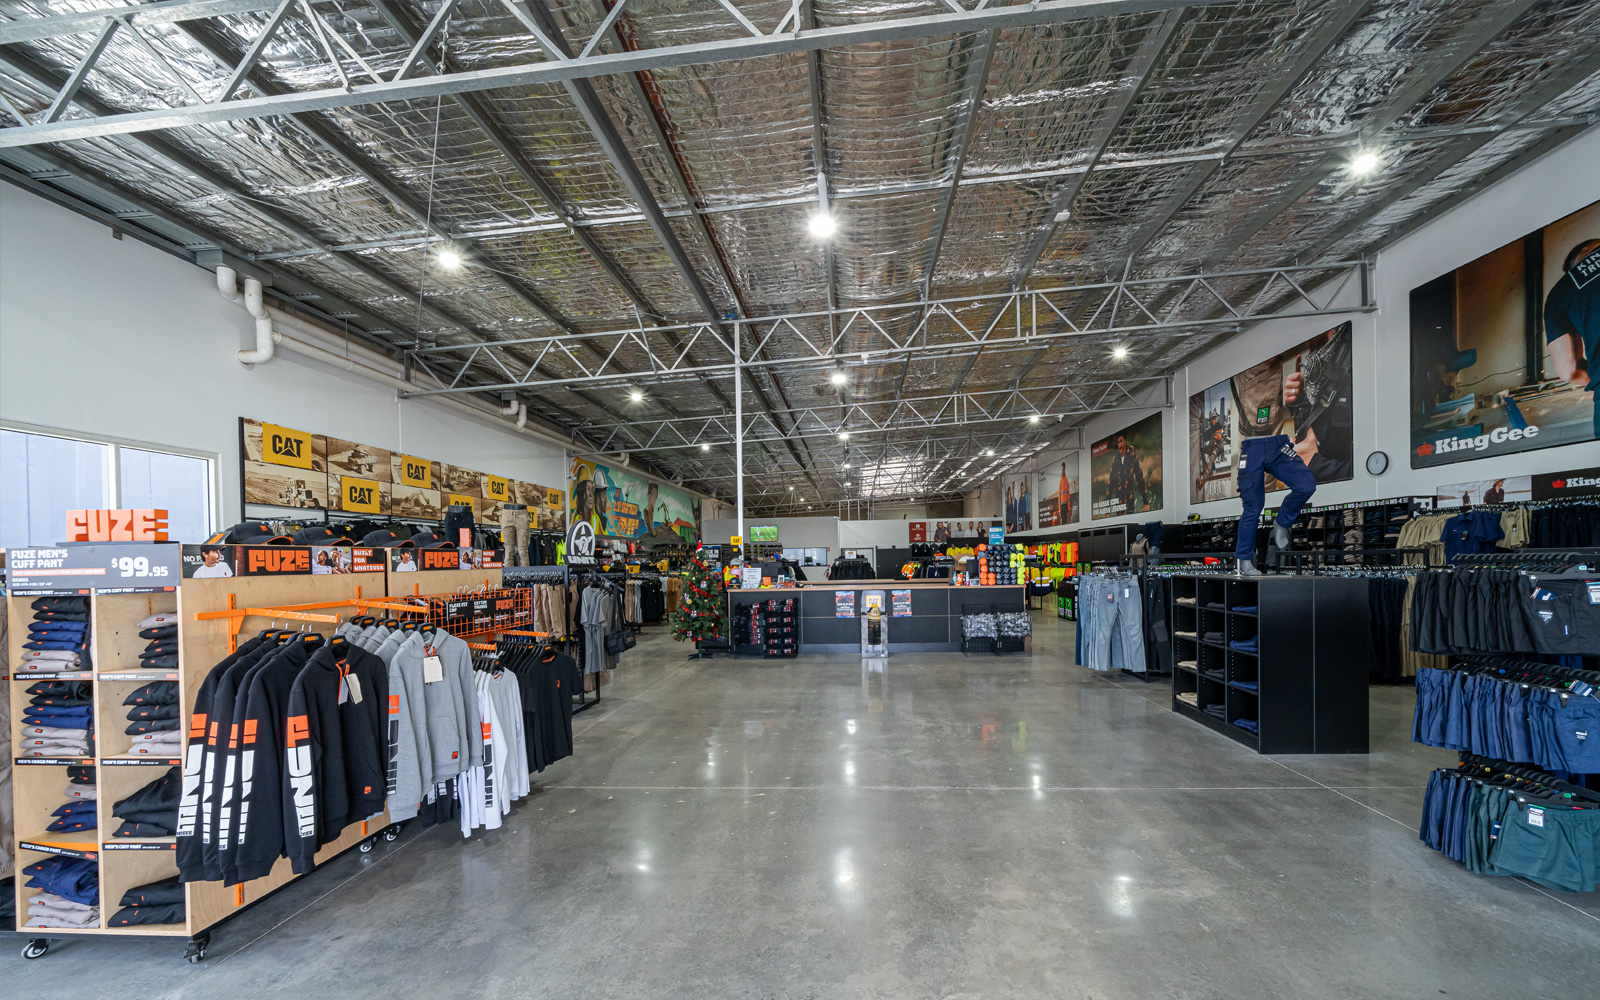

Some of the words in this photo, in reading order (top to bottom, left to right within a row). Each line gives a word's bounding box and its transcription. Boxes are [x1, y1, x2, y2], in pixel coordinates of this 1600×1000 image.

[272, 434, 303, 458] CAT
[1435, 425, 1539, 454] KingGee
[407, 463, 426, 480] CAT
[349, 486, 373, 505] CAT
[492, 481, 504, 494] CAT
[550, 493, 559, 504] CAT
[66, 509, 168, 542] FUZE
[11, 550, 36, 559] FUZE
[38, 549, 68, 558] MEN'S
[248, 549, 309, 572] FUZE
[424, 551, 458, 568] FUZE
[567, 555, 595, 564] UNIT
[11, 559, 35, 569] CUFF
[37, 559, 64, 568] PANT
[111, 556, 168, 578] $99.95
[495, 599, 513, 610] FUZE
